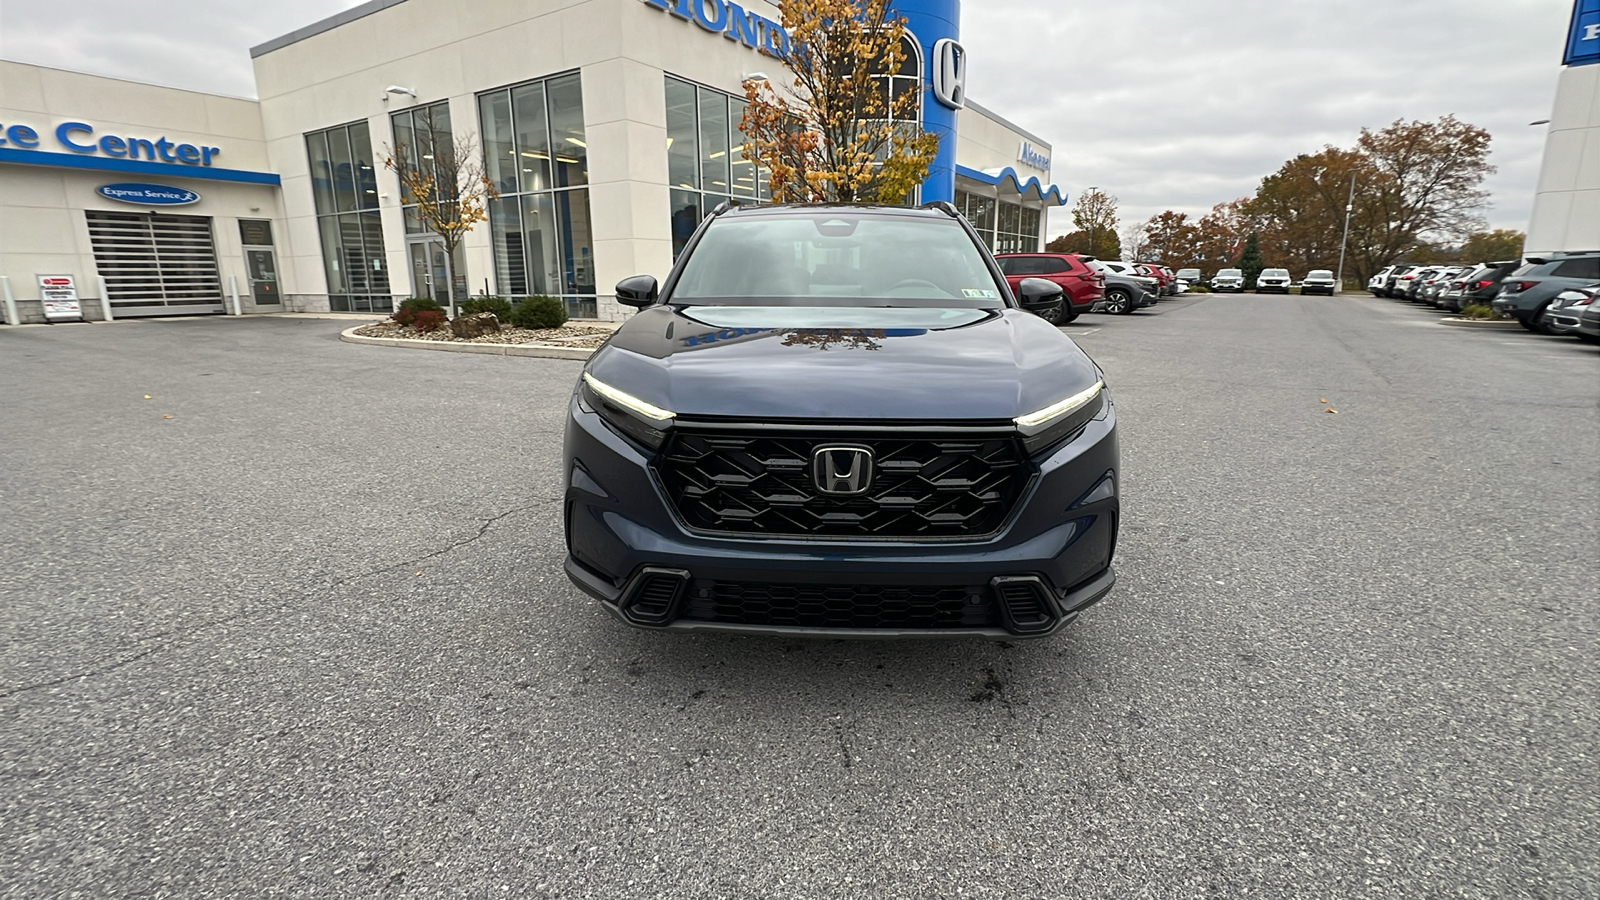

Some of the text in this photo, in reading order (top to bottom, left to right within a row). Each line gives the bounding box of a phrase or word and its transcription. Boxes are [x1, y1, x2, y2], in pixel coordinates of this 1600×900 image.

[55, 121, 220, 166] Center
[103, 187, 180, 199] Express Service
